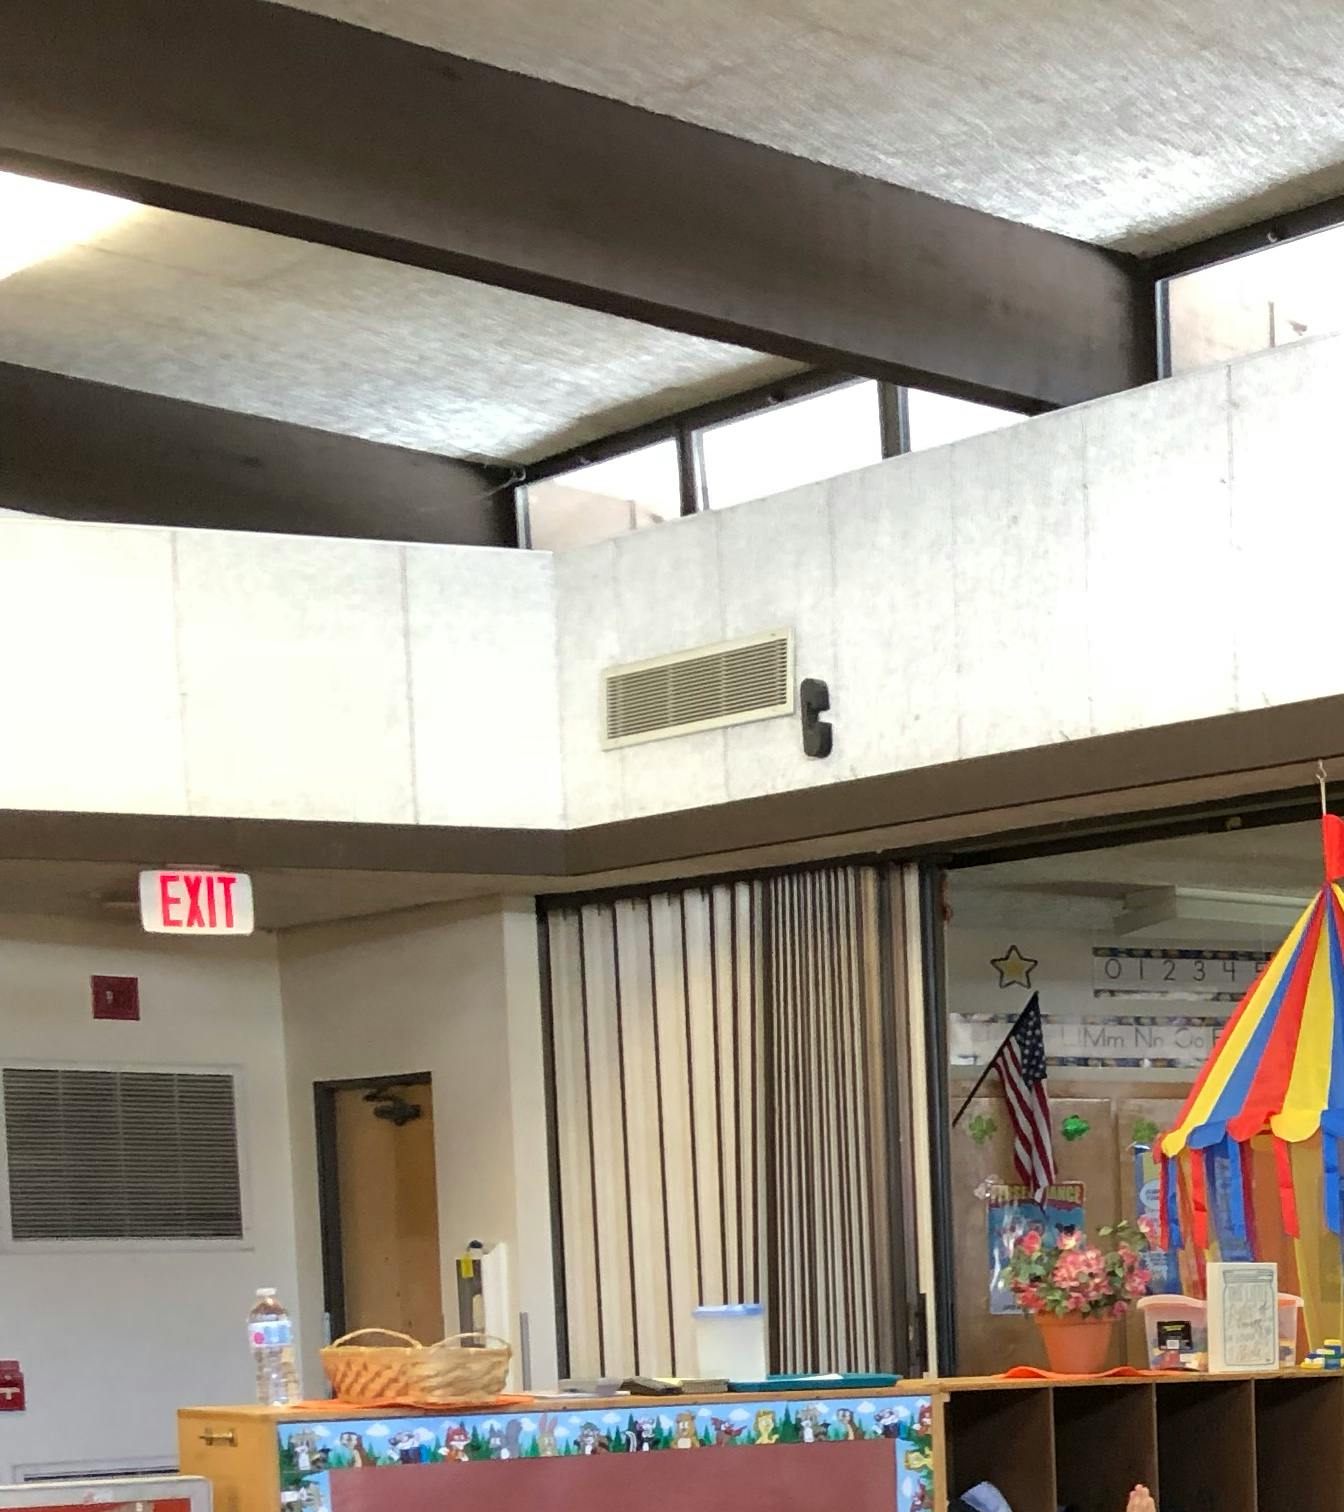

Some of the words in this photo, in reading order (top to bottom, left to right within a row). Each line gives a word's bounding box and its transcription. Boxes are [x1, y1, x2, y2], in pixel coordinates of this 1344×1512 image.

[160, 875, 236, 929] EXIT
[1163, 959, 1176, 981] 2
[1193, 960, 1206, 982] 3
[1223, 961, 1236, 982] 4
[1084, 1027, 1124, 1048] Mm
[1135, 1028, 1164, 1049] Nn
